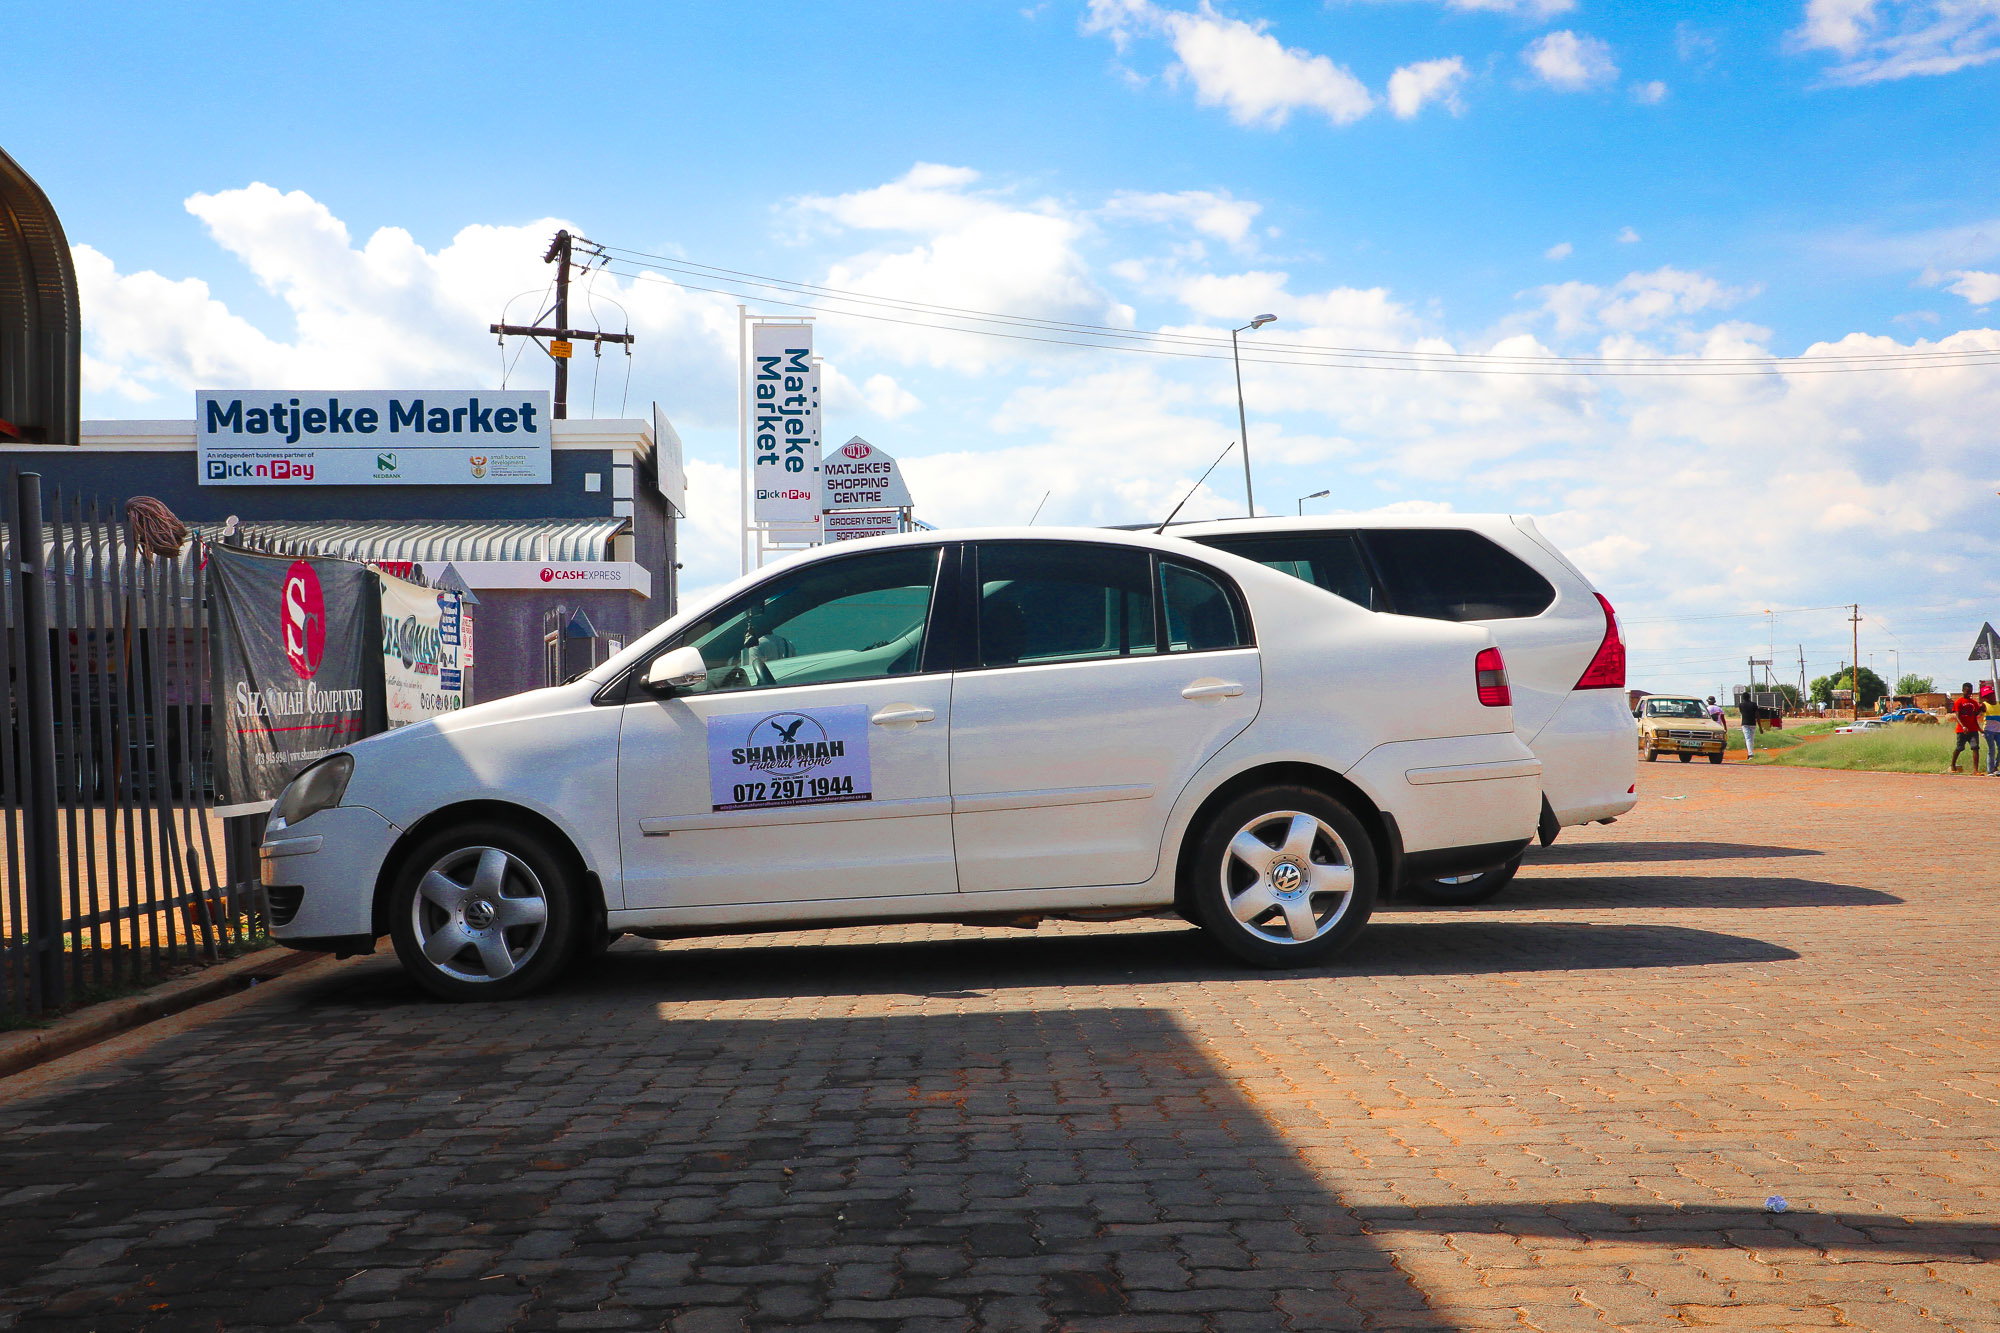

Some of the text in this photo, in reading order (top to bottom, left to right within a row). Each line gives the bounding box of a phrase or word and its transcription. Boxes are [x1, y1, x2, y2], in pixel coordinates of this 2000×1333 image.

[756, 356, 782, 466] Market
[777, 348, 810, 473] Matjeke
[206, 398, 537, 444] Matjeke Market
[207, 460, 254, 480] Pick
[270, 460, 314, 480] Pay
[825, 462, 891, 475] MATJEKE'S
[827, 477, 889, 490] SHOPPING
[757, 490, 780, 500] Pick
[788, 490, 811, 500] Pay
[834, 492, 882, 504] CENTRE
[830, 516, 866, 526] GROCERY
[866, 516, 892, 524] STORE
[307, 681, 363, 714] COMPUTER
[732, 740, 844, 765] SHAMMAH
[749, 754, 832, 771] Funeral Home
[733, 776, 854, 803] 072 297 1944
